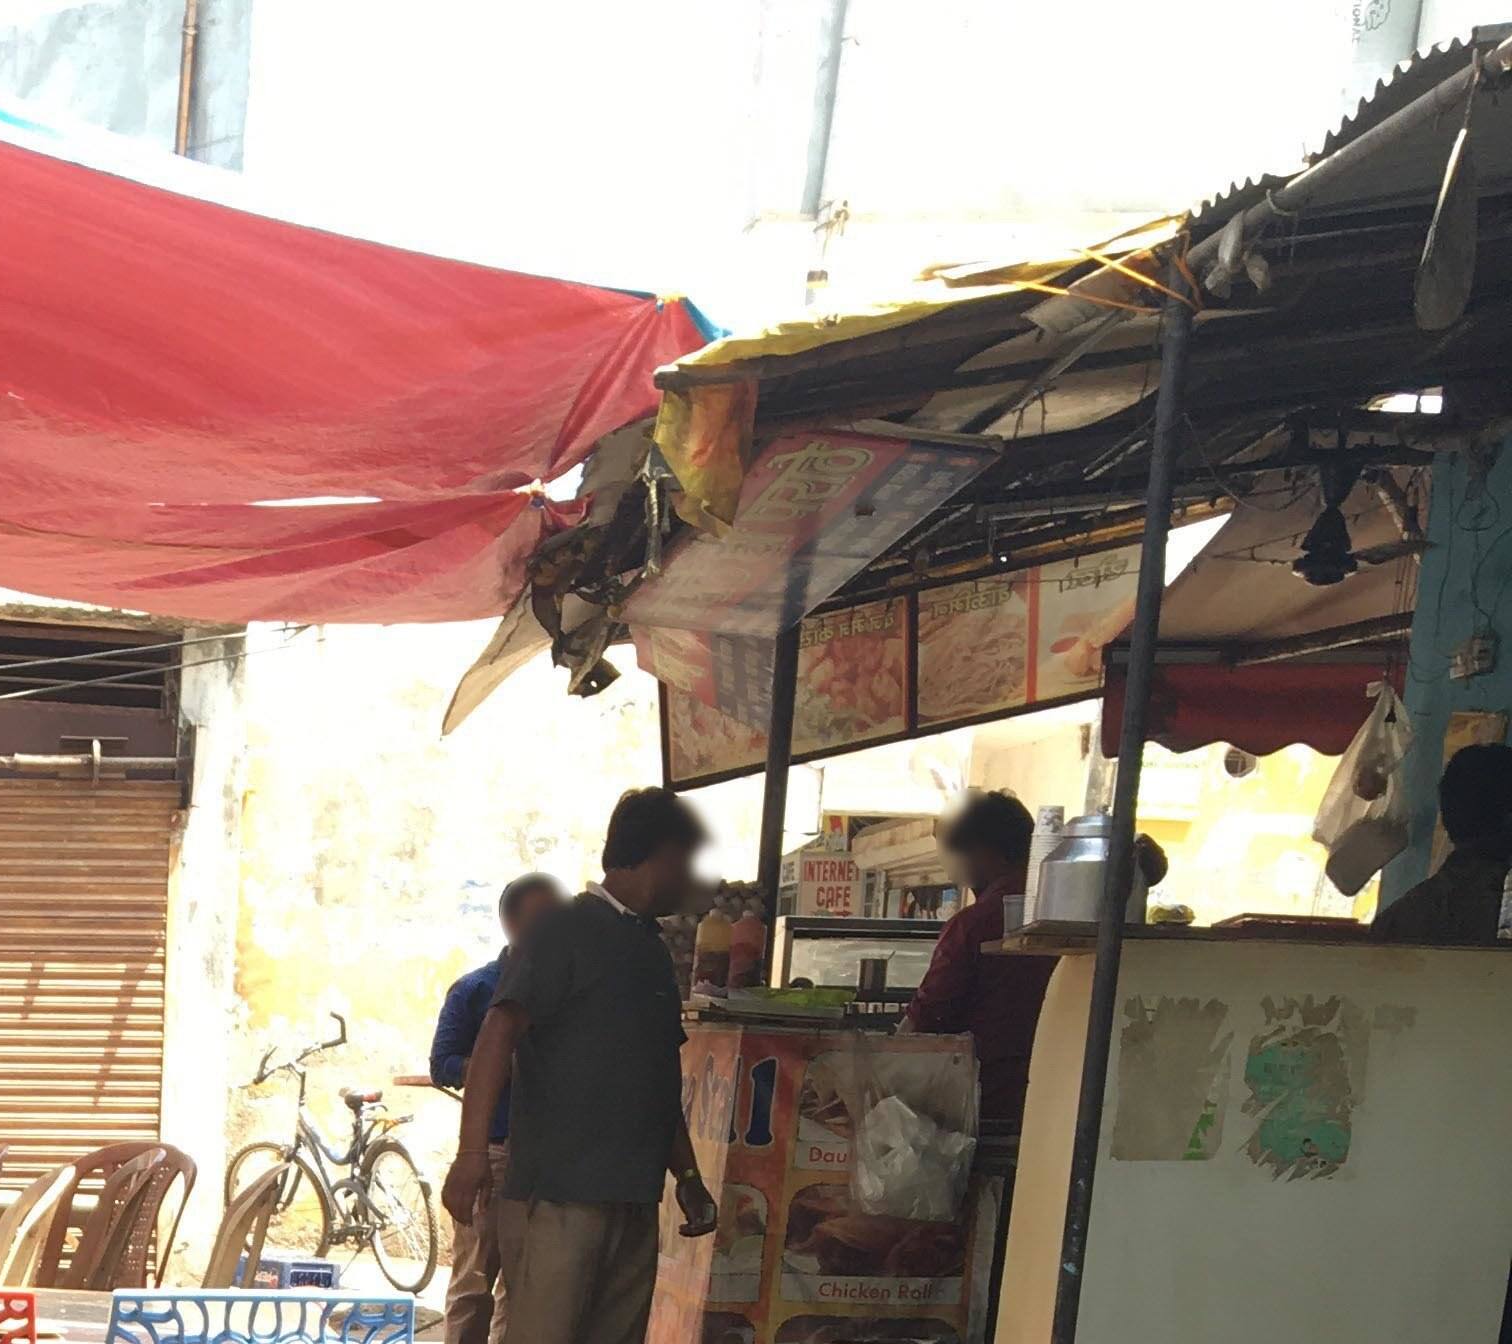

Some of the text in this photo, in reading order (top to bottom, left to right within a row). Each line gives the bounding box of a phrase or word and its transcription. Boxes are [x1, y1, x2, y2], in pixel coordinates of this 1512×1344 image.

[803, 859, 860, 881] INTERNET
[816, 885, 851, 908] CAFE
[809, 1146, 847, 1164] Dau
[818, 1281, 933, 1300] Chicken Roll
